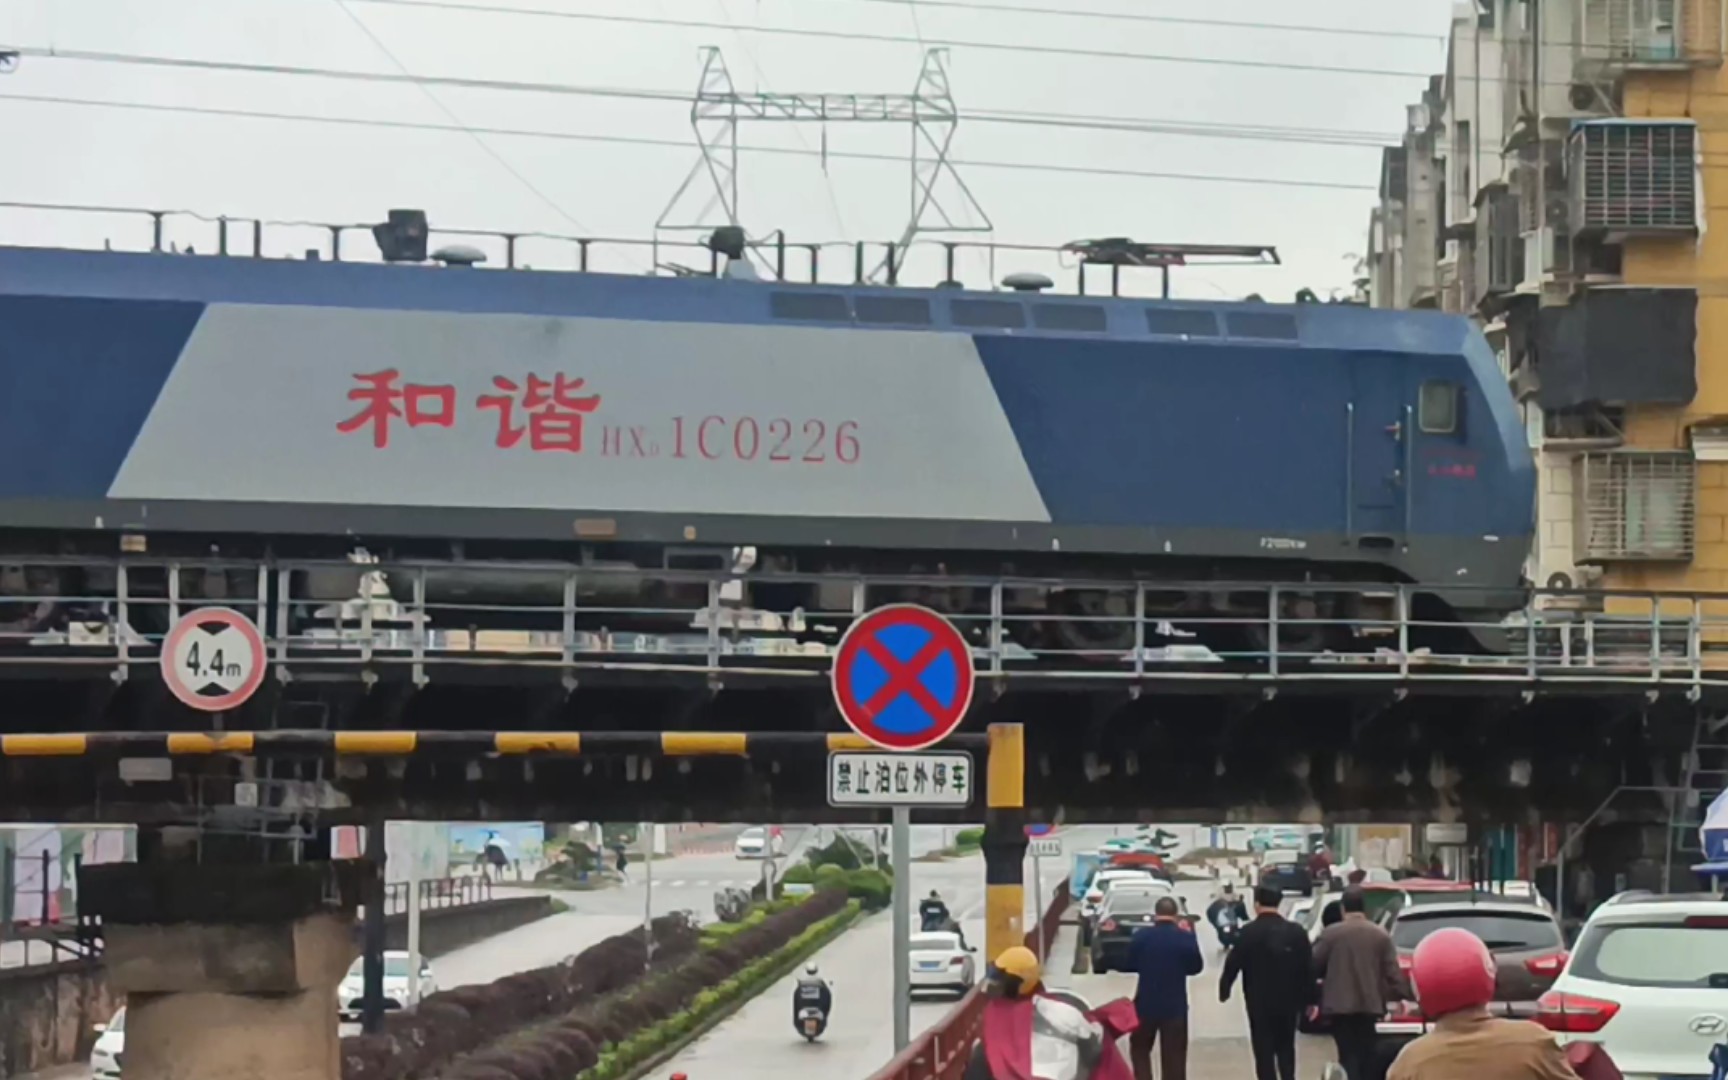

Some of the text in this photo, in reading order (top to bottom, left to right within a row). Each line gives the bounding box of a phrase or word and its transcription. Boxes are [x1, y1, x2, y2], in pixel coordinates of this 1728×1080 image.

[336, 368, 601, 452] 和谐
[186, 641, 241, 676] 4.4m
[837, 760, 965, 794] 禁止泊位外停车
